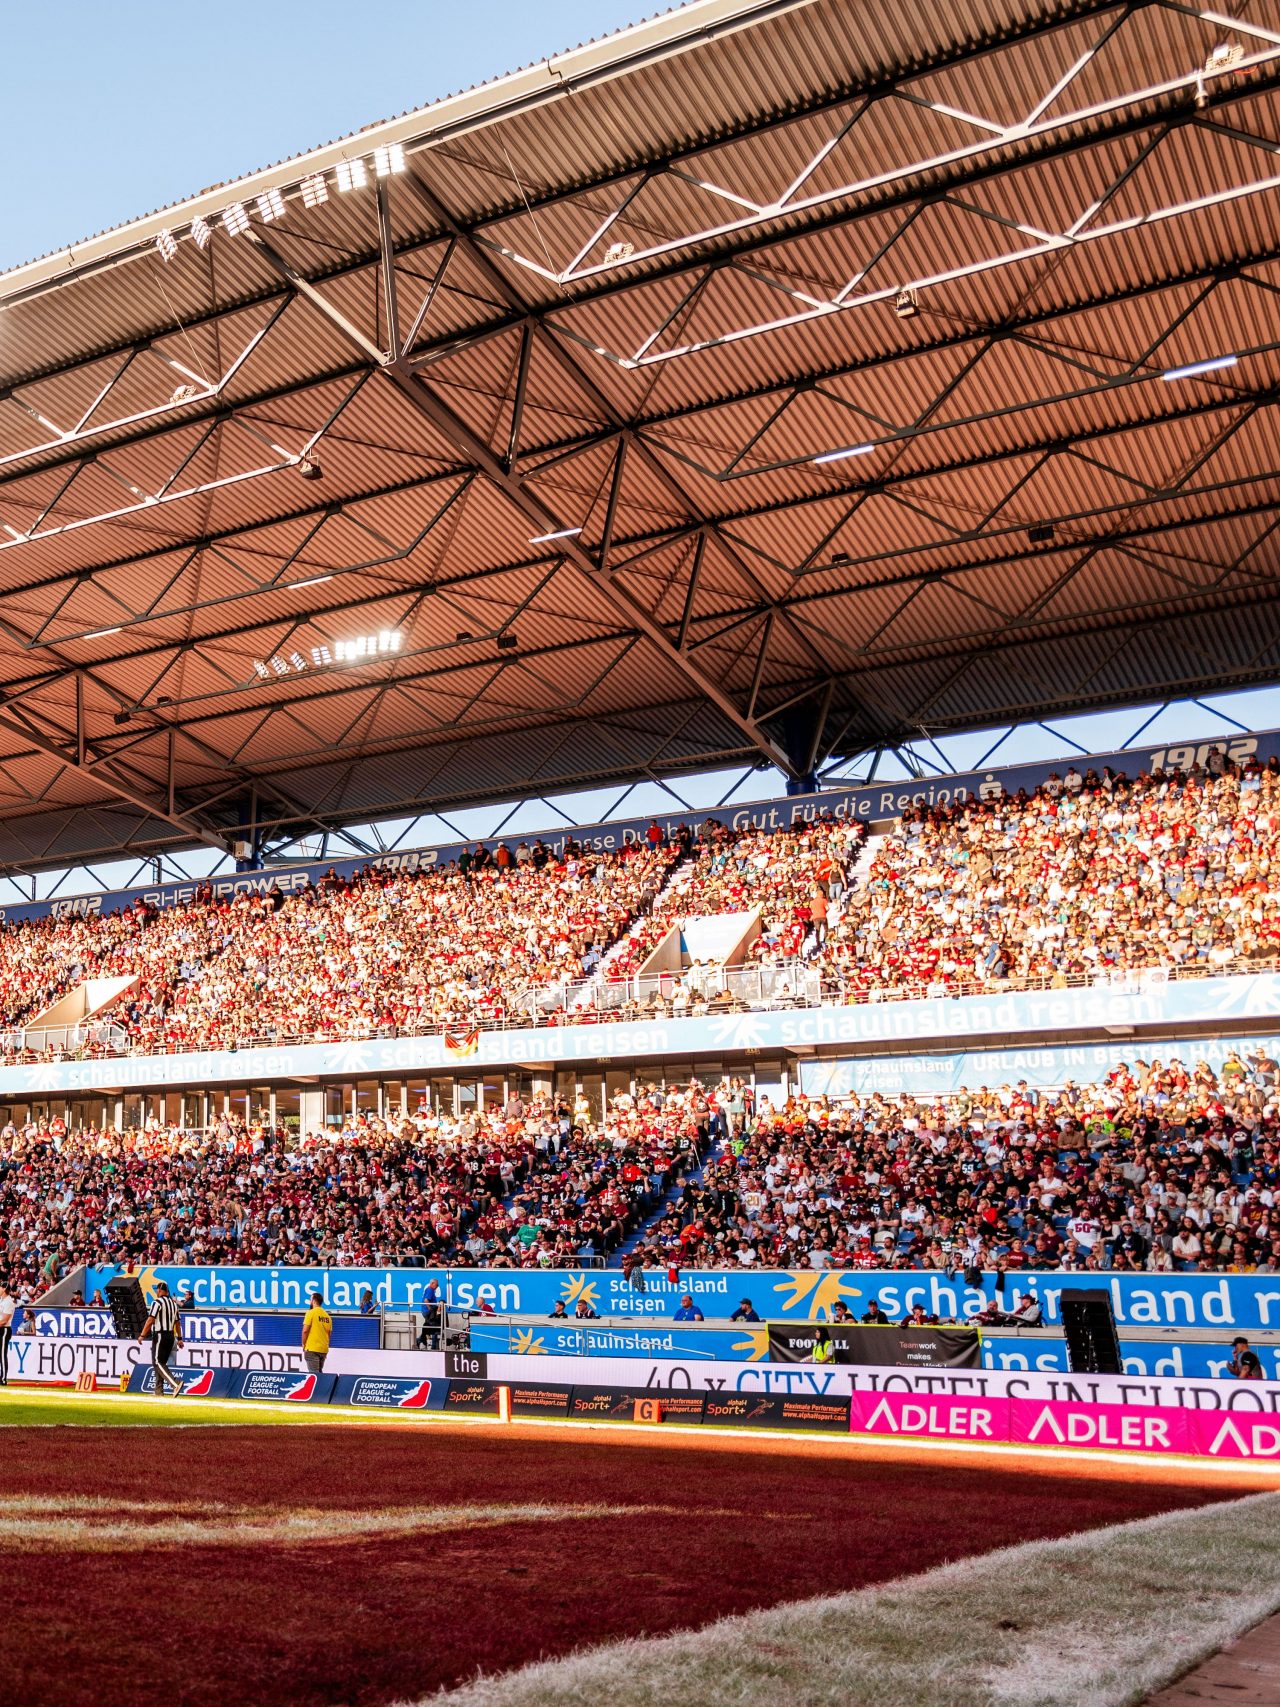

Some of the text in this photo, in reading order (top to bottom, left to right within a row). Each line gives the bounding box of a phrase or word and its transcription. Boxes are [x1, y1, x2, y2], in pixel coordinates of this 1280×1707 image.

[1150, 739, 1259, 776] 1902
[732, 783, 968, 832] Gut. Für die Region
[142, 872, 311, 907] RHEPOWER
[781, 999, 1014, 1043] schauinsland
[379, 1026, 669, 1068] schansland reisen
[856, 1056, 955, 1075] schauinsland
[972, 1051, 1055, 1072] URLAUB
[1062, 1049, 1085, 1066] IN
[69, 1053, 294, 1087] schauinsland reisen
[856, 1073, 904, 1089] reisen
[1074, 1222, 1091, 1233] 50
[176, 1270, 392, 1310] schauinsland
[610, 1297, 665, 1313] reisen
[877, 1276, 1236, 1324] schauinland
[60, 1312, 117, 1336] max
[557, 1331, 673, 1350] schauinsland
[788, 1338, 850, 1351] FOOTLL
[898, 1341, 937, 1350] Teamwork
[38, 1342, 140, 1380] HOTELS
[907, 1352, 932, 1361] makes
[453, 1357, 480, 1374] the
[78, 1373, 92, 1391] 10
[249, 1381, 273, 1389] LEAGUE
[251, 1374, 286, 1383] EUROPEAN
[360, 1381, 397, 1391] EUROPEAN
[247, 1387, 280, 1396] FOOTBALL
[356, 1395, 392, 1403] FOOTBALL
[358, 1388, 384, 1397] LEAGUE
[449, 1391, 482, 1402] Sport+
[515, 1389, 569, 1399] Maximale Performance
[736, 1369, 836, 1396] CITY
[1127, 1385, 1280, 1413] EURO
[574, 1399, 611, 1411] Sport+
[670, 1397, 704, 1406] Performance
[706, 1403, 747, 1415] Sport+
[783, 1402, 848, 1413] Maximale Performance
[639, 1401, 653, 1420] G
[864, 1397, 994, 1437] ADLER
[1027, 1405, 1171, 1449] ADLER
